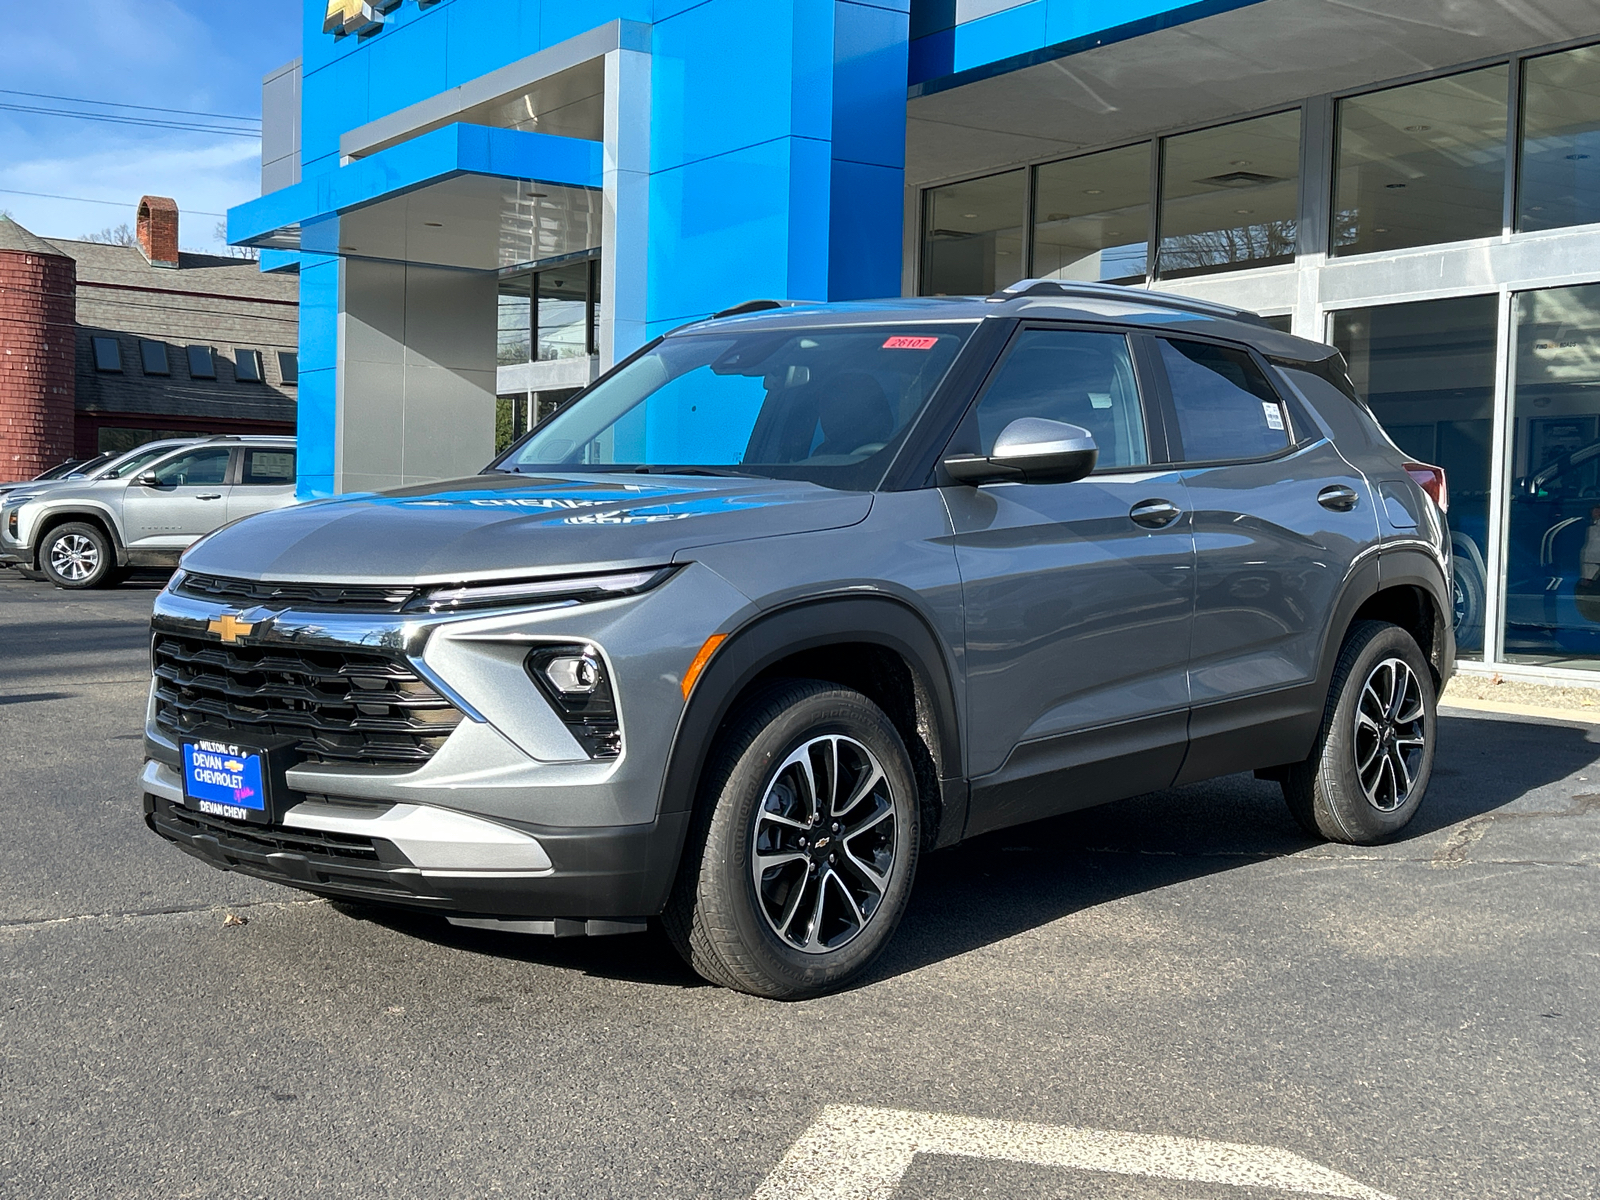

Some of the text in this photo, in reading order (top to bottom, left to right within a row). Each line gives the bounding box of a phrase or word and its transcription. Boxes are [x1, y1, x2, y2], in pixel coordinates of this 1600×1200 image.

[890, 339, 929, 348] 26107
[228, 744, 239, 756] CT
[193, 752, 222, 771] DEVAN
[194, 769, 243, 789] CHEVROLET
[199, 800, 247, 820] DEVAN CHEVY
